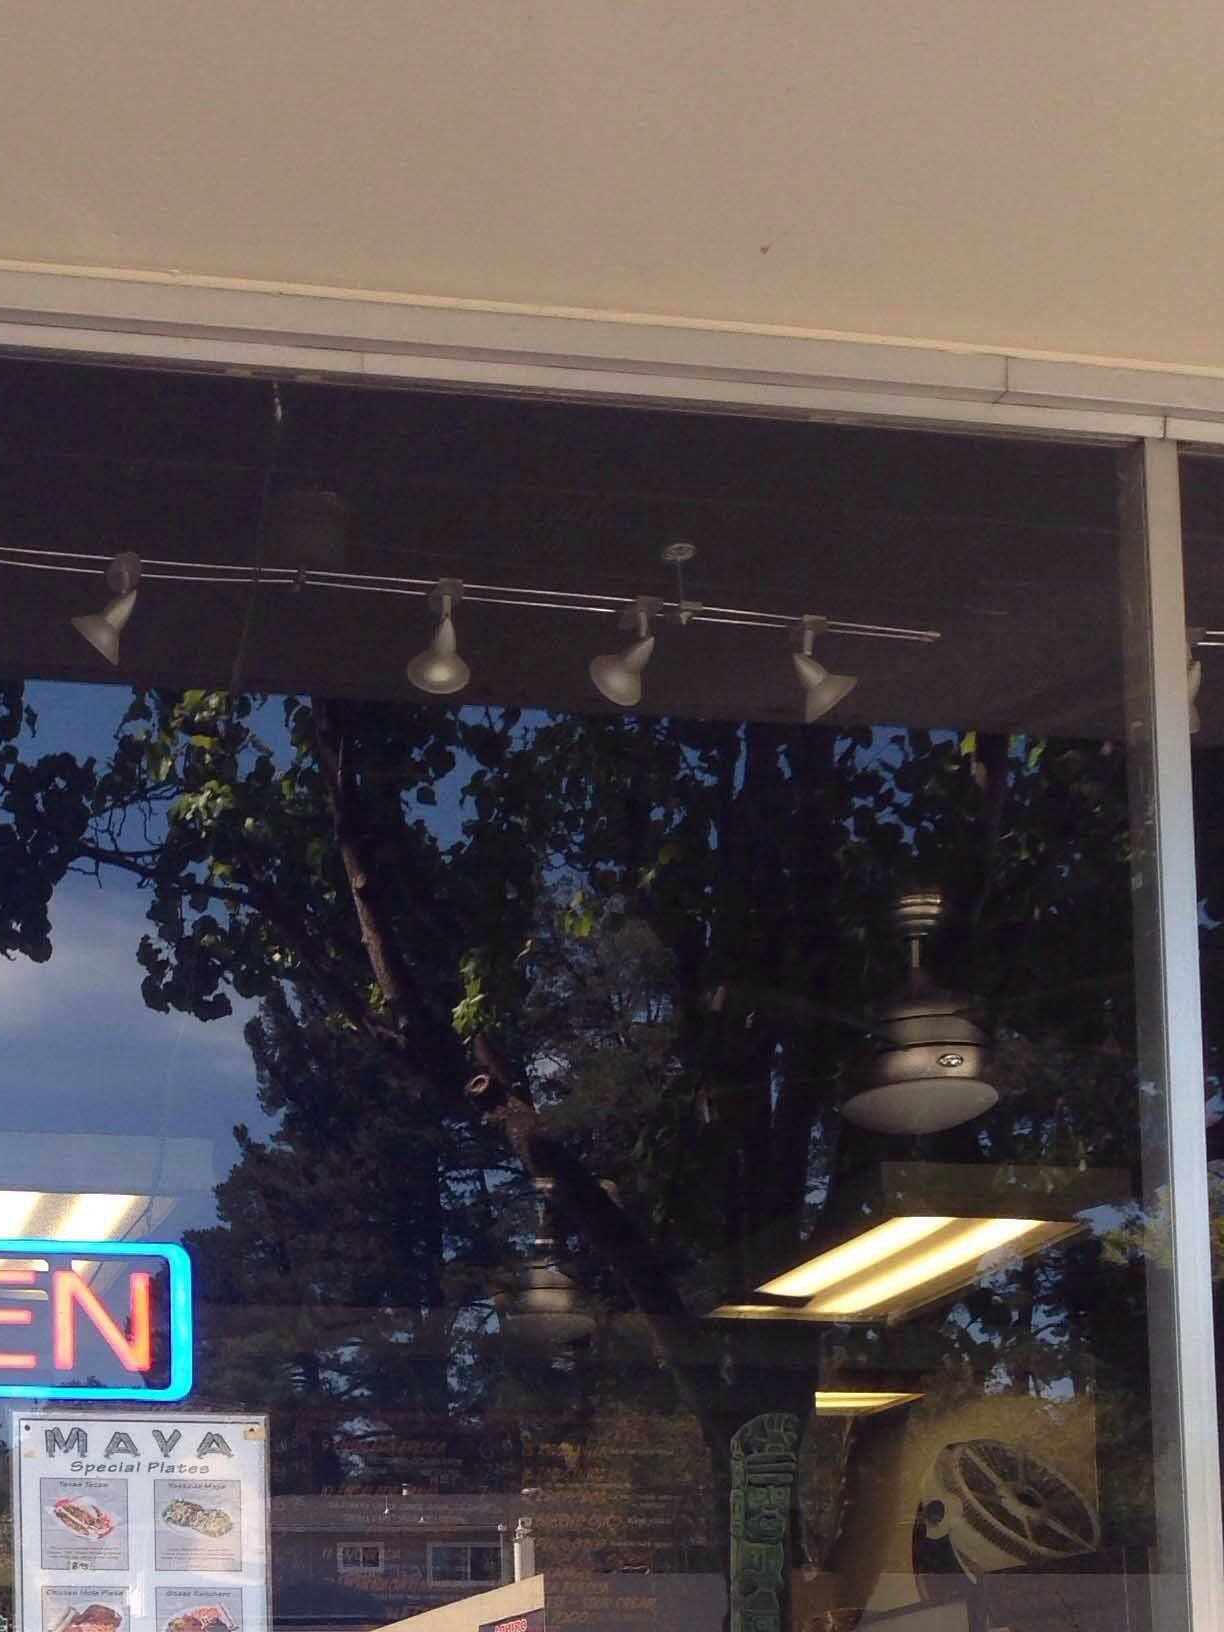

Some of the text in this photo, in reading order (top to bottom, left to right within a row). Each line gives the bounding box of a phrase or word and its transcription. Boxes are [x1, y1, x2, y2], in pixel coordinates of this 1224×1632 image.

[45, 1426, 234, 1459] MAYA
[70, 1460, 210, 1476] Special Plates
